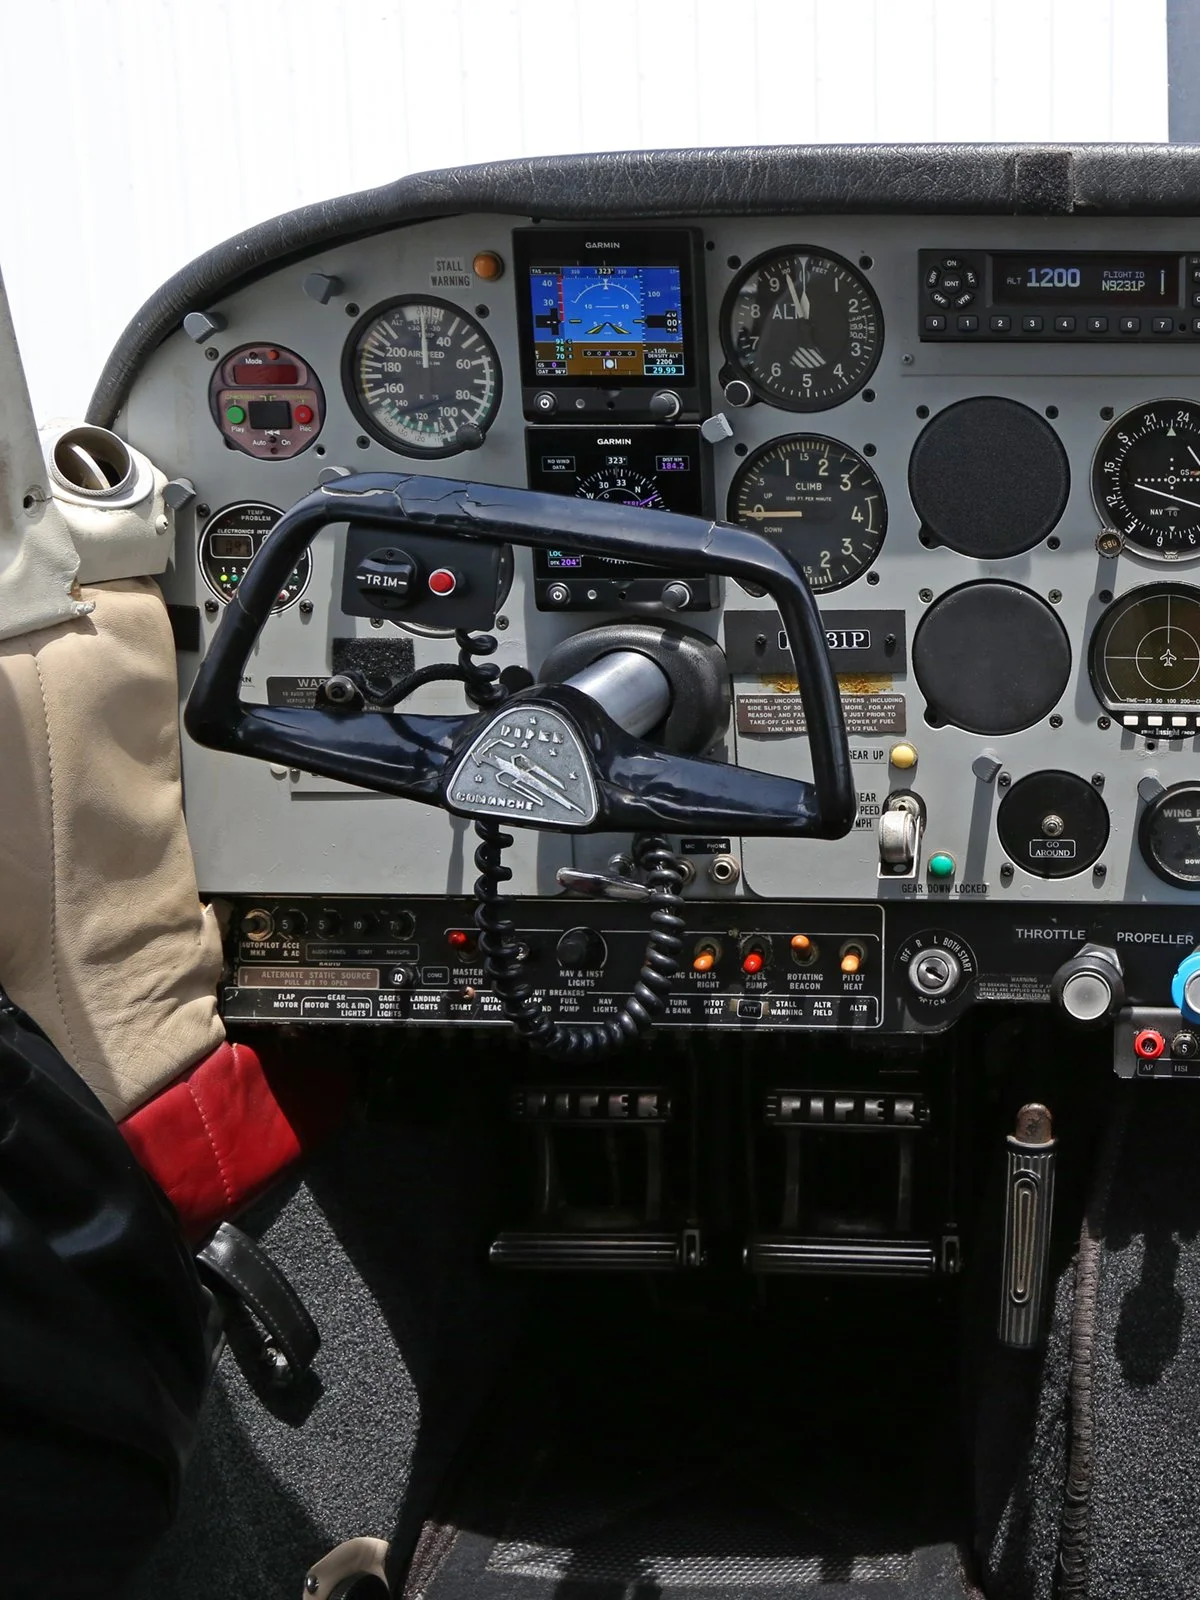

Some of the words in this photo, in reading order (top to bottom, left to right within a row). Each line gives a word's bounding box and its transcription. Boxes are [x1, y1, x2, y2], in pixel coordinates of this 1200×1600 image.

[436, 261, 462, 272] STALL
[430, 276, 470, 286] WARNING
[1026, 268, 1081, 288] 1200
[1102, 281, 1146, 292] N9231P
[386, 347, 408, 358] 200
[383, 362, 402, 372] 180
[384, 384, 404, 394] 160
[456, 390, 470, 400] 80
[438, 407, 458, 418] 100
[796, 482, 822, 490] CLIMB
[366, 574, 399, 588] TRIM
[501, 725, 564, 744] PIPER
[1156, 728, 1180, 736] Insight
[456, 792, 534, 810] COMANCHE
[1163, 809, 1192, 817] WING
[855, 819, 872, 828] MPH
[902, 884, 919, 894] GEAR
[928, 884, 950, 894] DOWN
[955, 884, 988, 894] LOCKED
[1016, 929, 1086, 940] THROTTLE
[1117, 932, 1194, 945] PROPELLER
[958, 950, 972, 973] START
